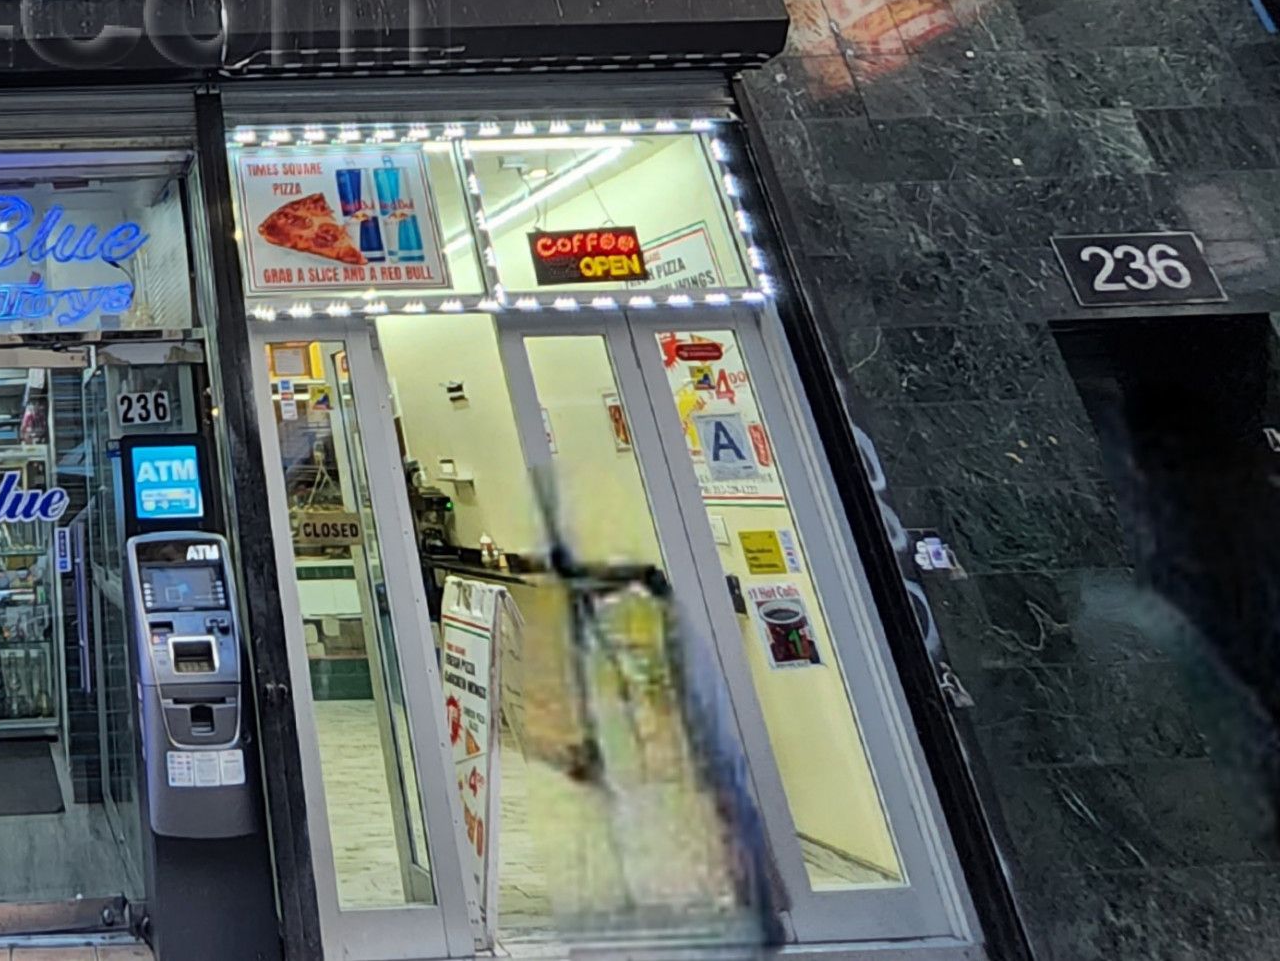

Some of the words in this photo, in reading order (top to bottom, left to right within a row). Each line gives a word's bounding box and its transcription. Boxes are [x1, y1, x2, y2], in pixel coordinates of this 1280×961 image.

[246, 163, 279, 176] TIMES
[282, 162, 323, 176] SQUARE
[272, 183, 303, 196] PIZZA
[263, 268, 293, 284] GRAB
[298, 268, 305, 282] A
[308, 268, 340, 282] SLICE
[344, 267, 366, 282] AND
[370, 267, 378, 281] A
[381, 266, 402, 281] RED
[406, 265, 434, 280] BULL
[579, 254, 641, 277] OPEN
[1080, 243, 1192, 292] 236
[120, 392, 168, 423] 236
[712, 421, 746, 461] A
[137, 458, 197, 483] ATM
[301, 522, 359, 539] CLOSED
[186, 544, 220, 561] ATM
